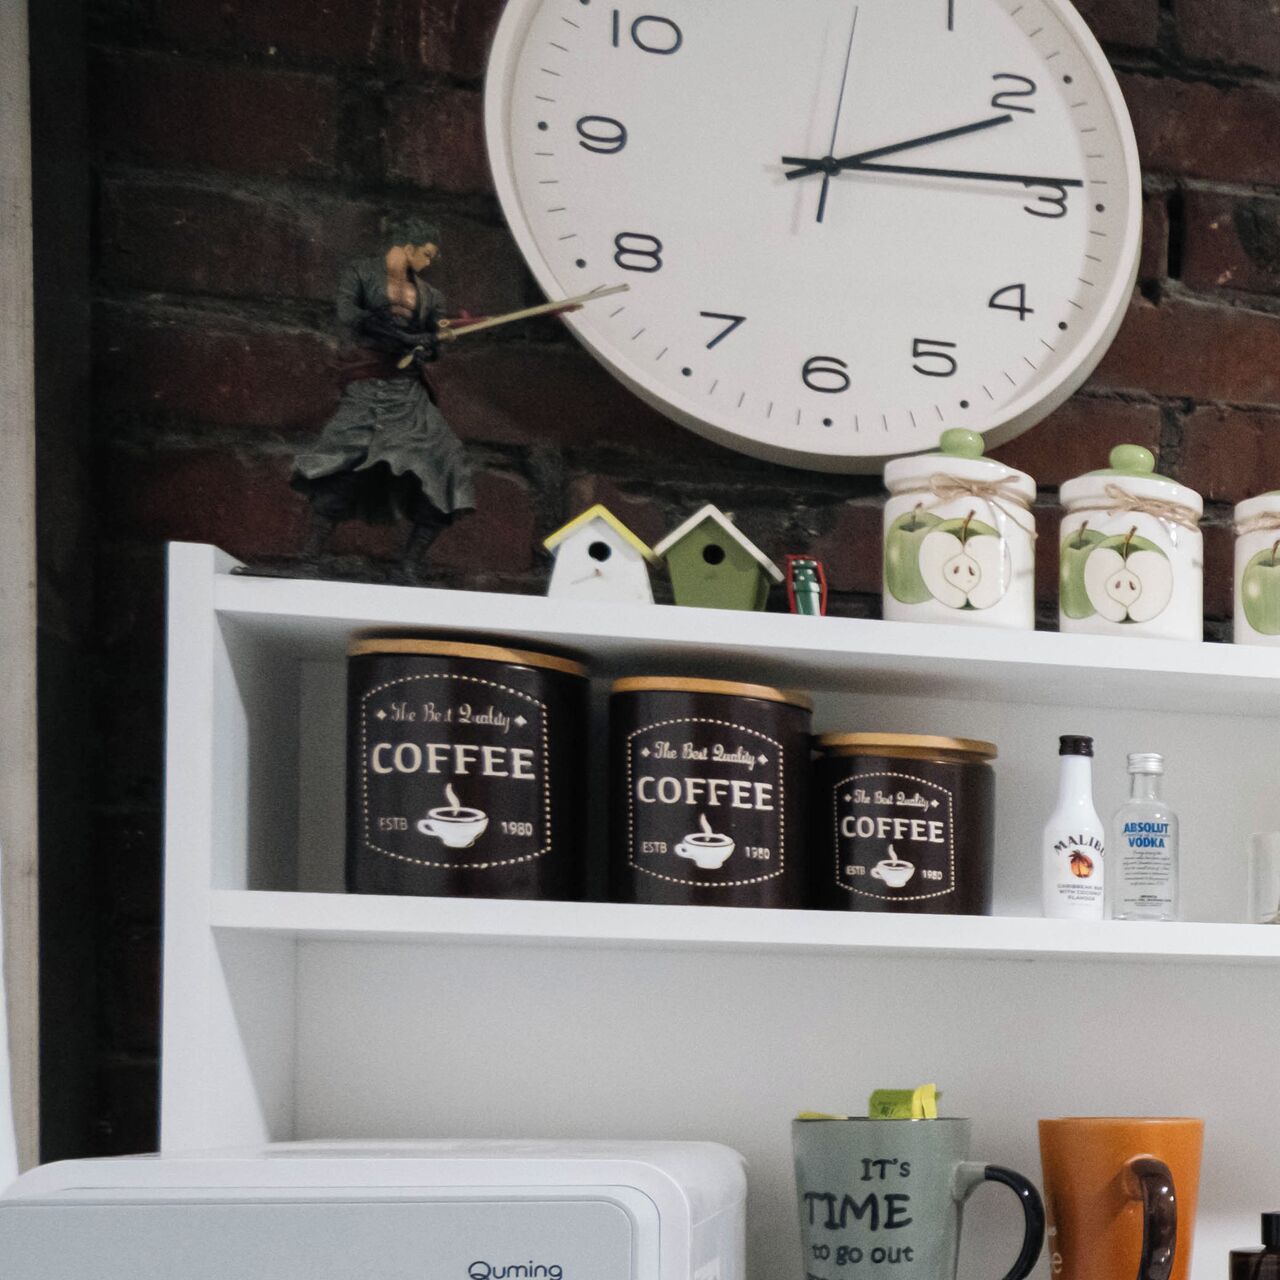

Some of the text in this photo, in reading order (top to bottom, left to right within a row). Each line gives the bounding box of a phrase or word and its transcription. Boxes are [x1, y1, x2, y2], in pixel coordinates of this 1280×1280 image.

[611, 9, 683, 56] 10
[990, 73, 1037, 114] 2
[576, 114, 628, 154] 9
[1022, 180, 1068, 219] 3
[613, 231, 663, 273] 8
[988, 283, 1035, 321] 4
[700, 310, 746, 350] 7
[801, 355, 851, 394] 6
[911, 338, 957, 378] 5
[372, 742, 536, 780] COFFEE
[654, 741, 678, 759] The
[712, 743, 756, 771] Quality
[637, 776, 774, 811] COFFEE
[379, 817, 533, 836] ESTB 1980
[842, 816, 945, 843] COFFEE
[1124, 822, 1169, 833] ABSOLUT
[1128, 837, 1165, 848] VODKA
[642, 841, 771, 860] ESTB 1980
[860, 1157, 911, 1181] IT'S
[804, 1191, 913, 1231] TIME
[812, 1244, 914, 1266] to go out
